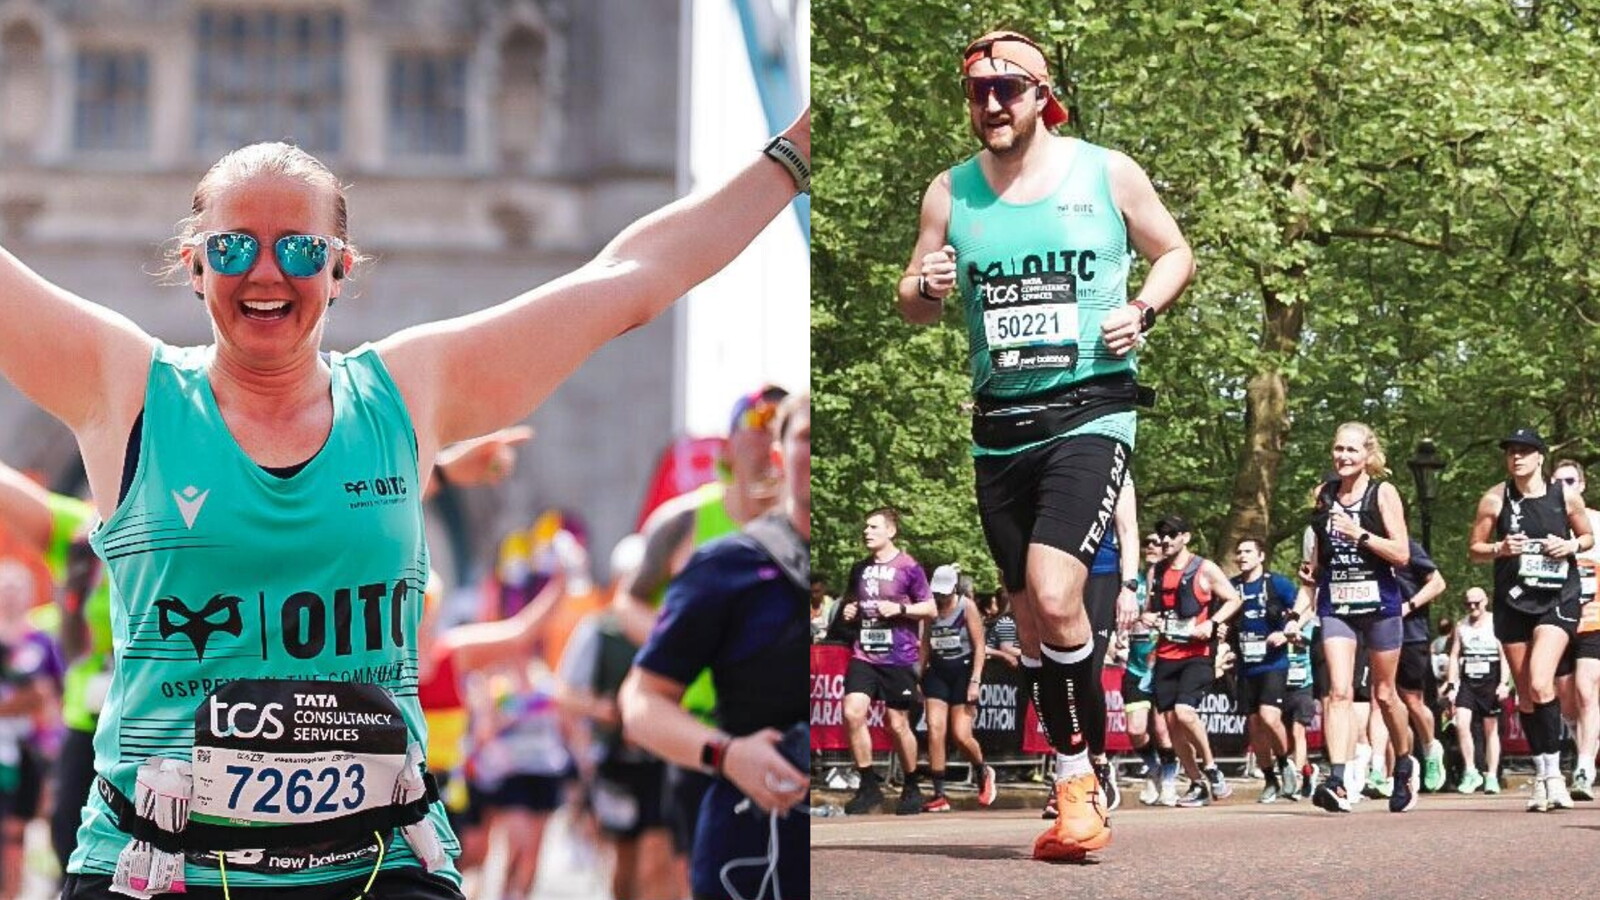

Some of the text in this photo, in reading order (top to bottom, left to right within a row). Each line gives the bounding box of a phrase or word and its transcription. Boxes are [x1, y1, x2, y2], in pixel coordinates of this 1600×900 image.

[998, 311, 1060, 340] 50221
[375, 475, 407, 496] OITC
[1080, 484, 1118, 555] TEAM
[281, 579, 408, 660] OITC
[293, 693, 338, 708] TATA
[209, 694, 285, 740] tcs
[293, 710, 393, 726] CONSULTANCY
[293, 726, 360, 742] SERVICES
[226, 763, 366, 815] 72623
[268, 855, 306, 869] new
[309, 844, 380, 869] balance
